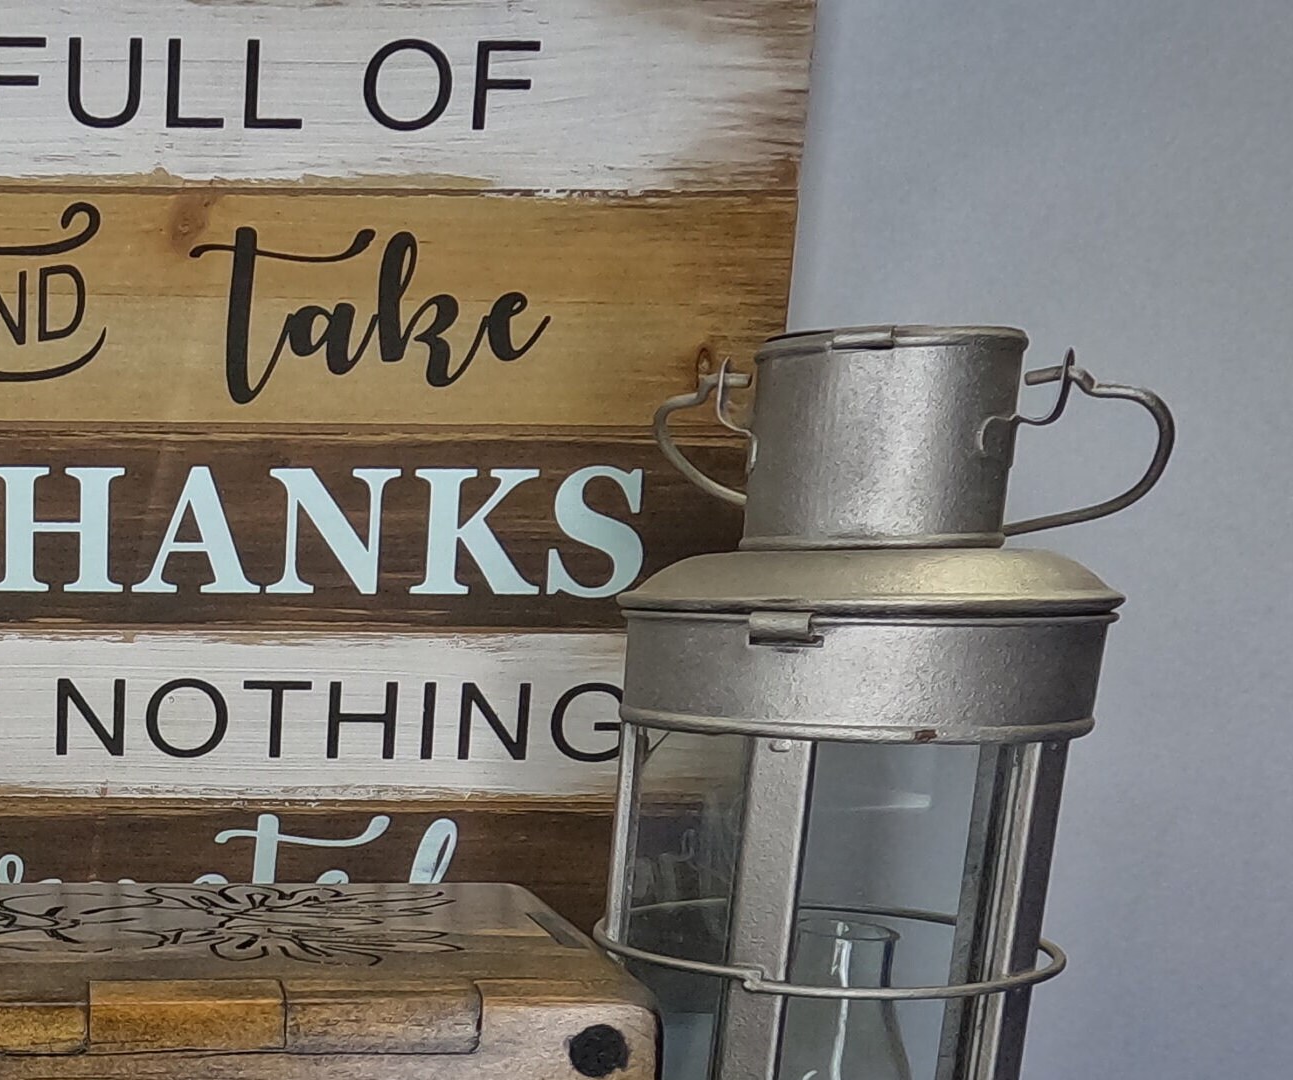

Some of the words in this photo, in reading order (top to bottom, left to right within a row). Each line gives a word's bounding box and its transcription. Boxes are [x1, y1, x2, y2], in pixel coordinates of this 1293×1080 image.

[363, 38, 542, 132] OF
[189, 226, 551, 405] take
[56, 678, 622, 763] NOTHING
